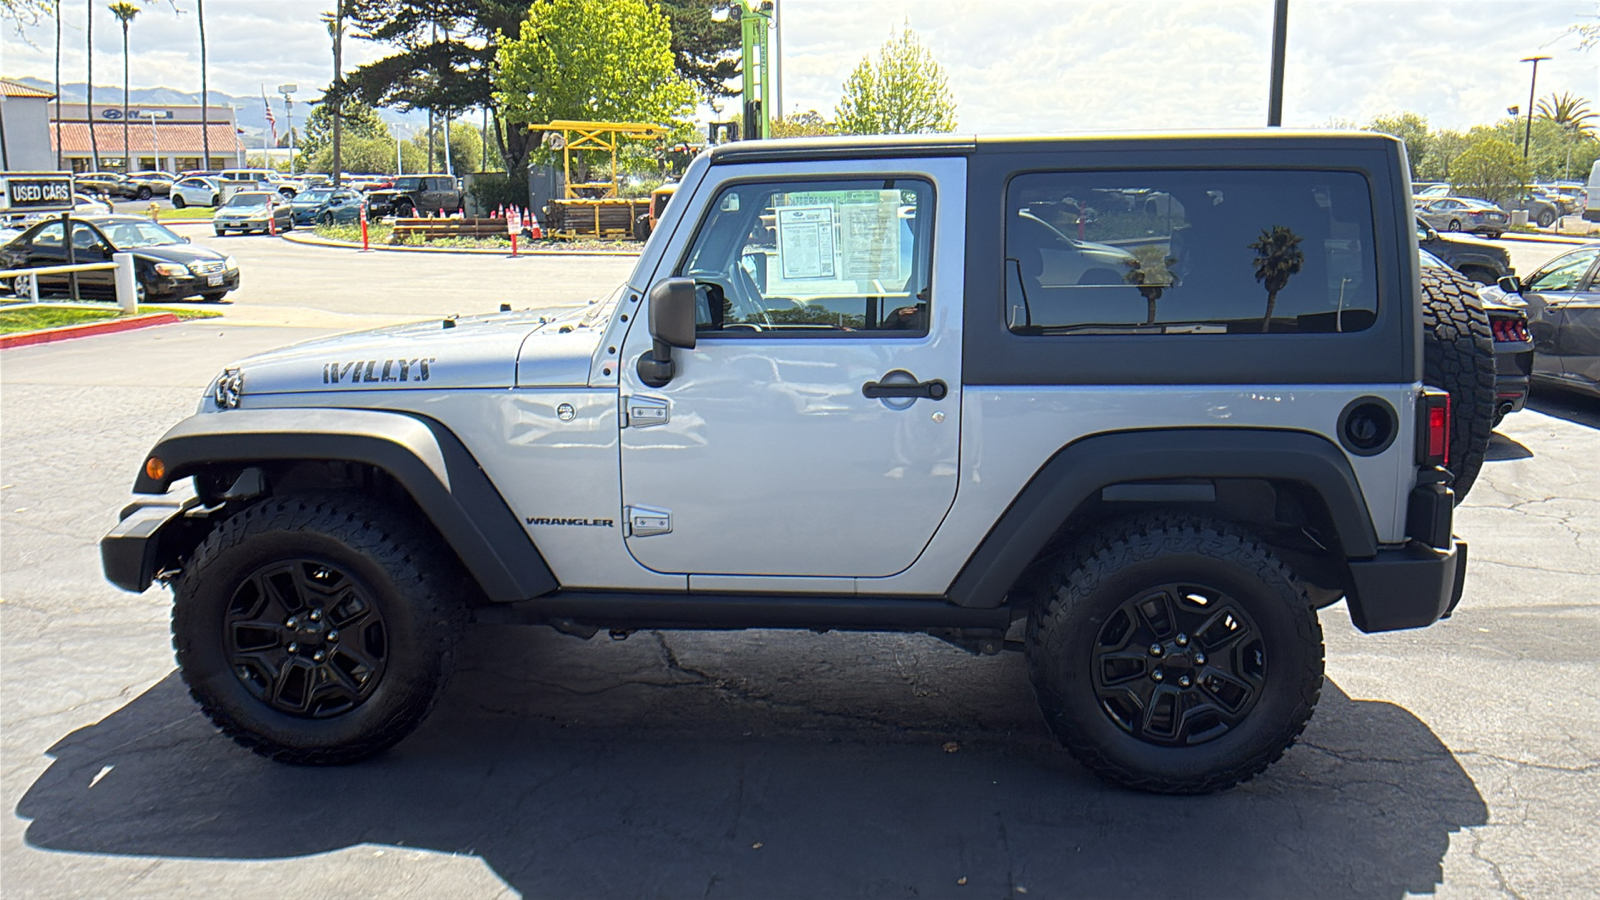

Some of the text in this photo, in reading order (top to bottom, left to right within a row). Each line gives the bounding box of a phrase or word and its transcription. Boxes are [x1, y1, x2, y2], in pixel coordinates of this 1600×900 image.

[13, 184, 69, 201] USED CARS
[323, 358, 435, 384] WILLYS
[525, 517, 614, 527] WRANGLER
